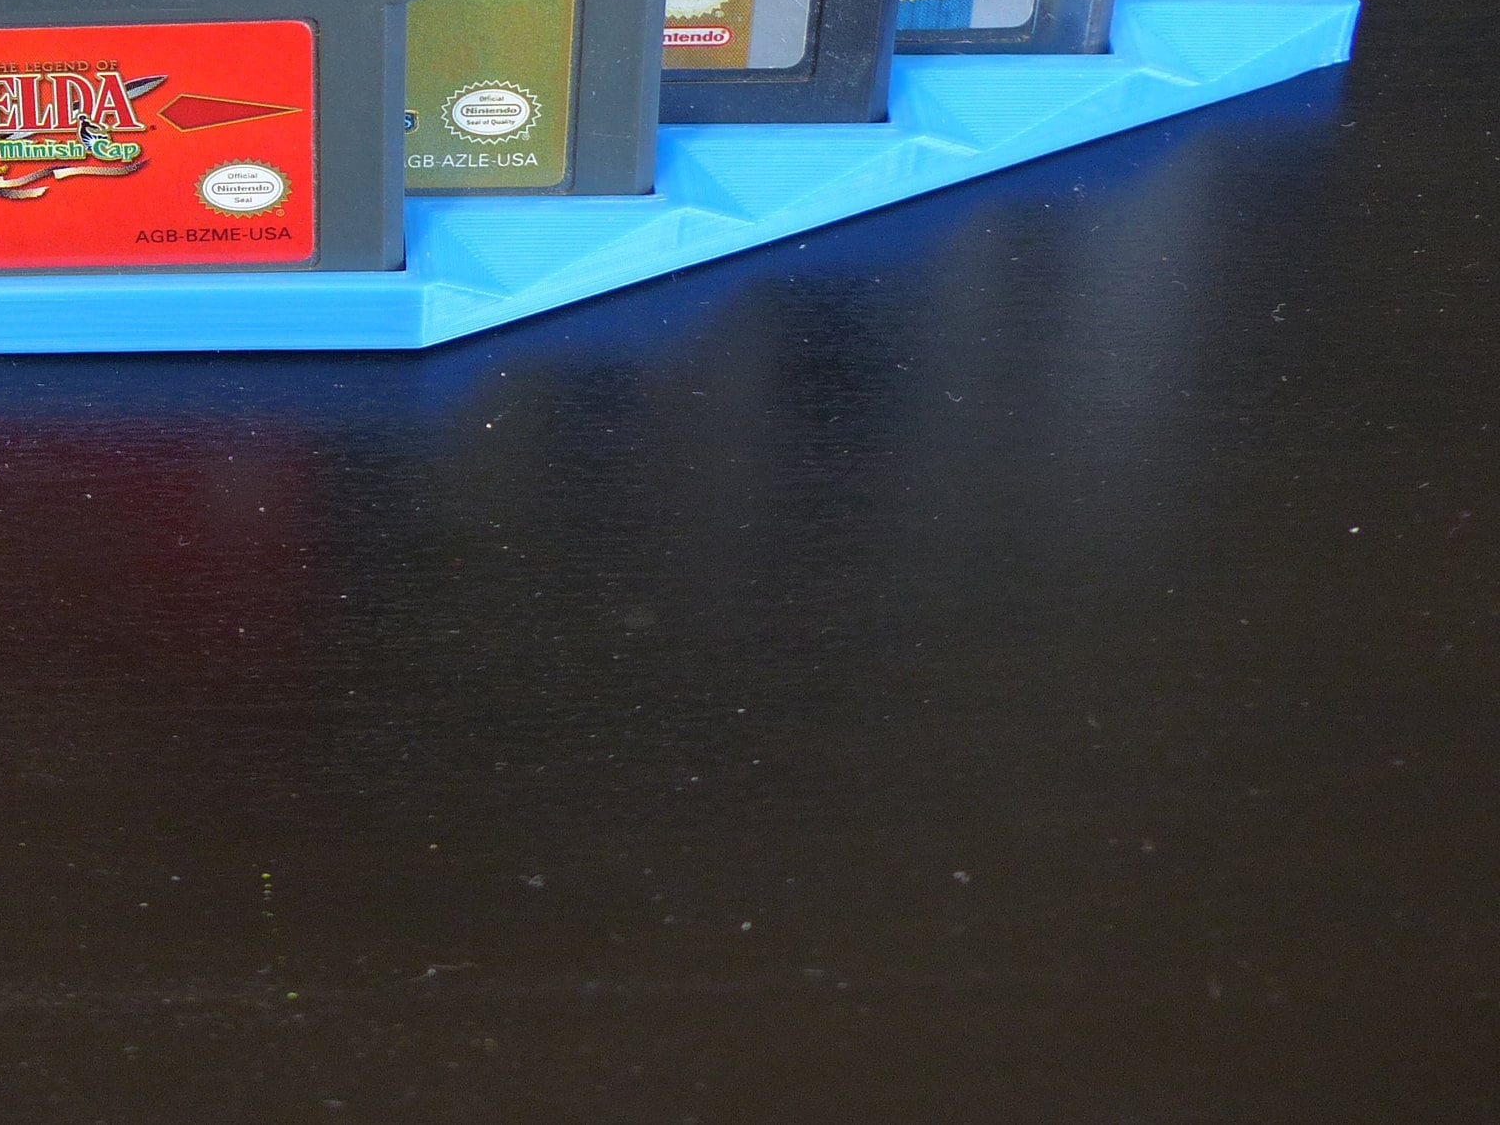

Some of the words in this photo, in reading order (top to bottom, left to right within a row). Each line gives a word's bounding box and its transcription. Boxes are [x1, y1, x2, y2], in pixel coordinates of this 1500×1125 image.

[662, 30, 725, 42] ntendo
[25, 60, 89, 72] LEGEND
[97, 59, 118, 71] OF
[465, 106, 518, 115] Nintendo
[0, 140, 85, 160] Minish
[92, 136, 141, 161] Cap
[404, 152, 539, 169] GB-AZLE-USA
[227, 172, 258, 180] Official
[217, 184, 270, 193] Nintendo
[234, 196, 253, 204] Seal
[135, 226, 293, 244] AGB-BZME-USA
